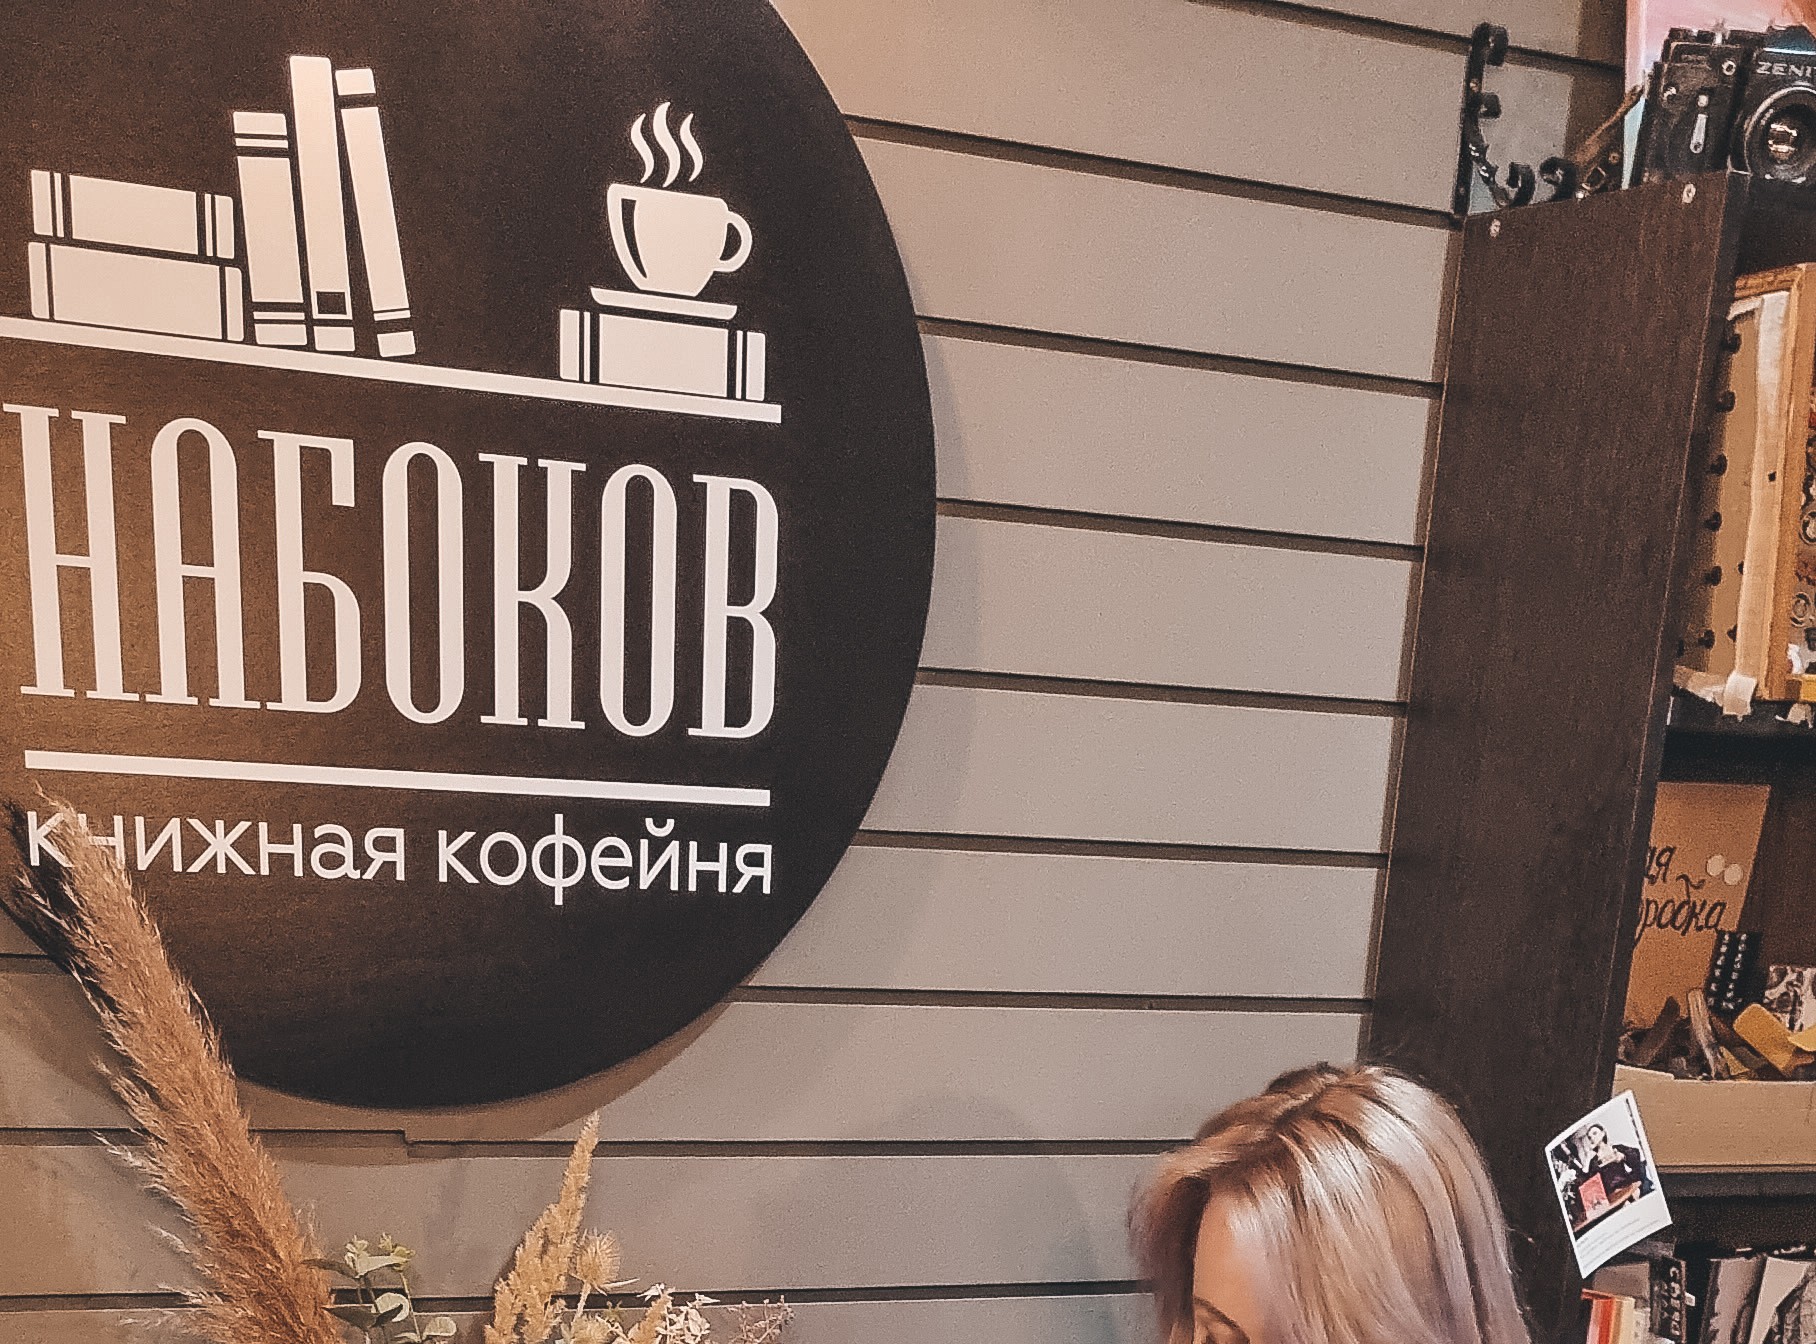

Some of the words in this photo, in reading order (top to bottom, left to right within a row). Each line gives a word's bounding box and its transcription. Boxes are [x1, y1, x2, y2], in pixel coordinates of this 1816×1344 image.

[1756, 61, 1816, 78] ZENI
[3, 403, 780, 741] НАБОКОВ
[26, 810, 406, 881] книжная
[438, 814, 774, 904] кофейня
[1635, 873, 1727, 946] робка
